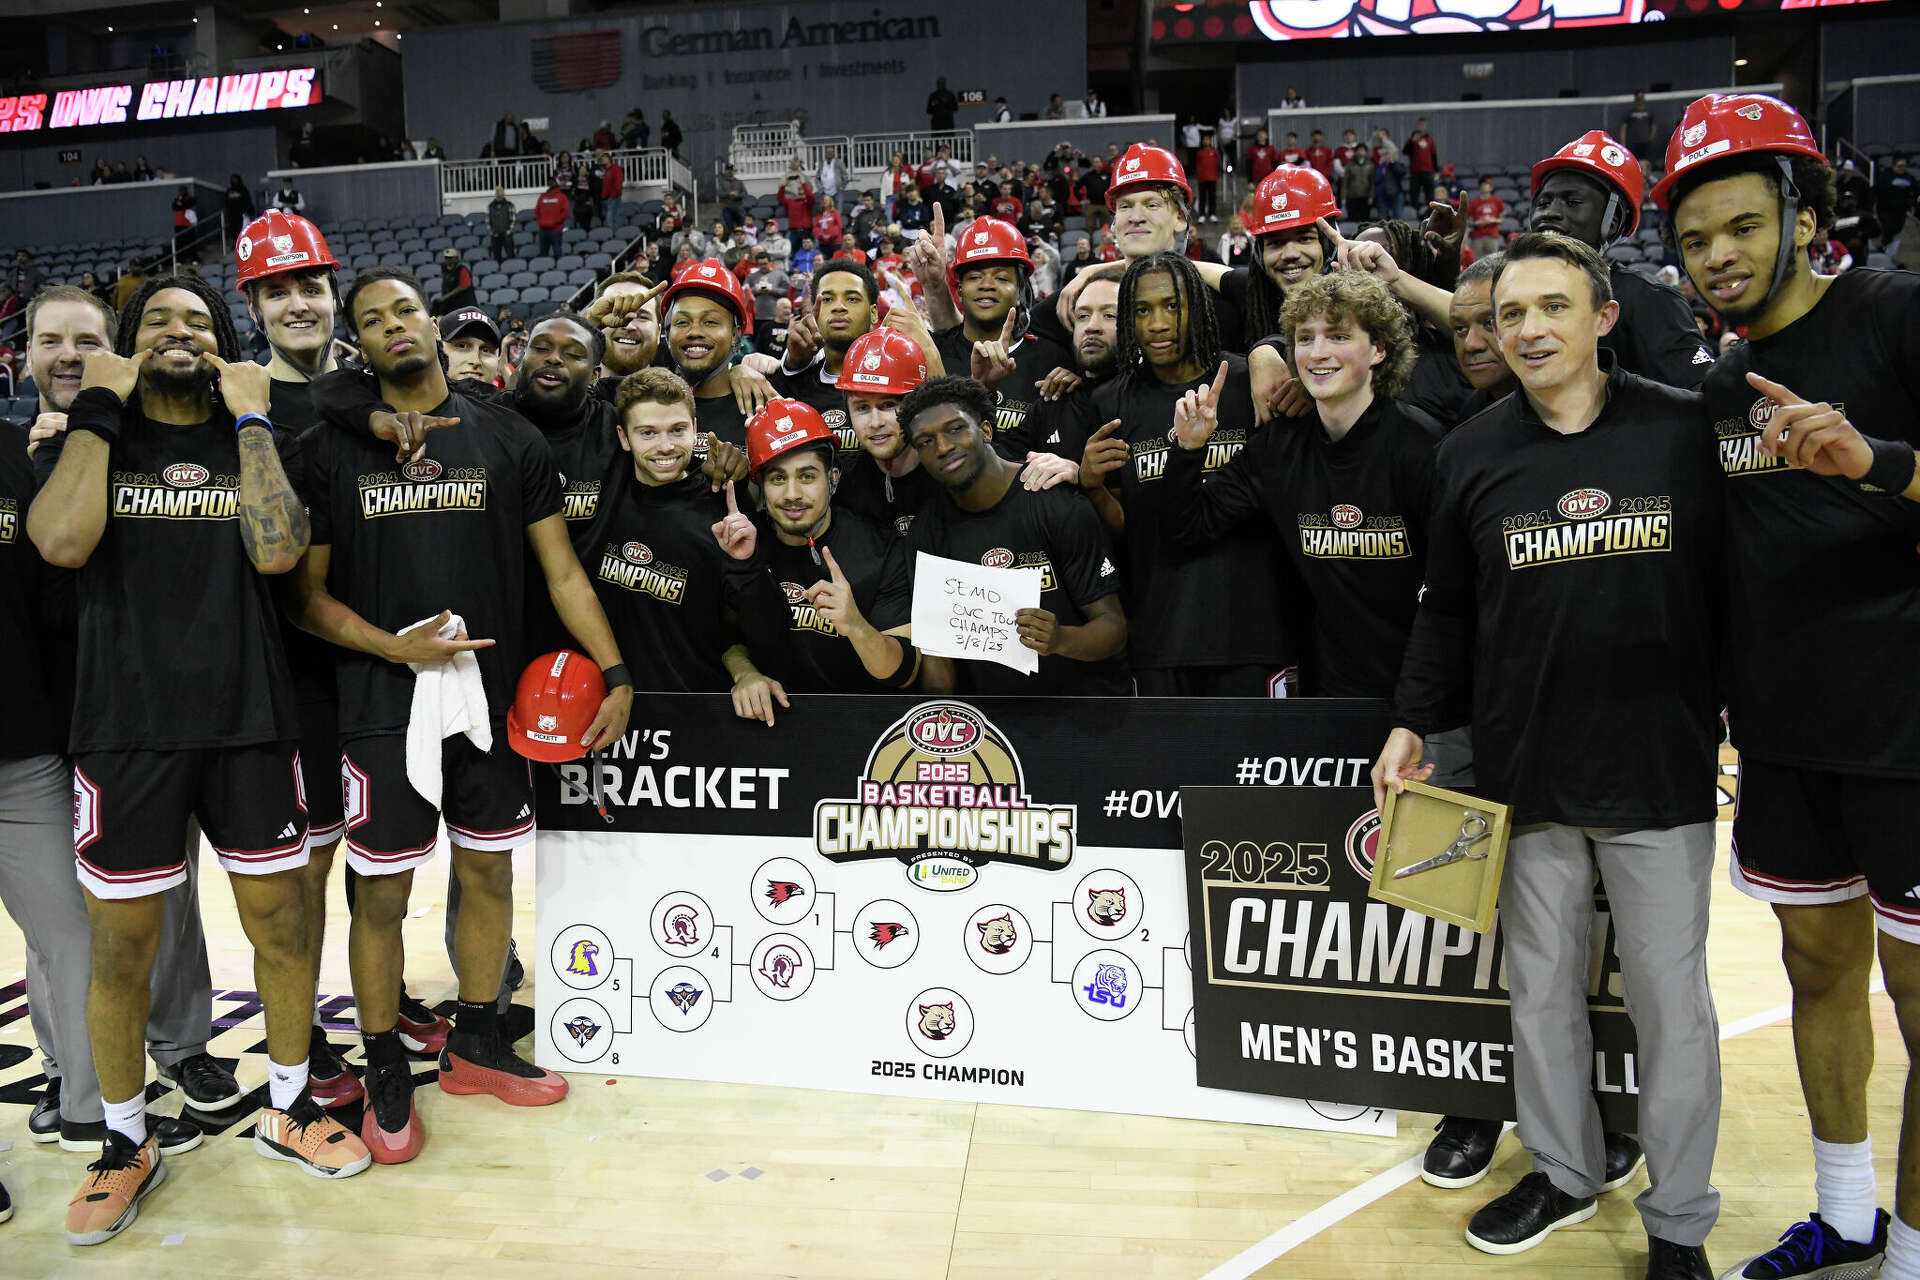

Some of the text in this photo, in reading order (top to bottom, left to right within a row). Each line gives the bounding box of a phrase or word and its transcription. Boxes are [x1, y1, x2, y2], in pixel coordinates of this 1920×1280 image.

[641, 8, 942, 57] German American
[49, 85, 133, 128] OVC
[136, 68, 316, 121] CHAMPS
[962, 91, 983, 102] 106
[62, 151, 78, 162] 104
[1688, 147, 1710, 163] POLK
[1271, 211, 1292, 220] THOMAS
[271, 252, 304, 263] THOMPSON
[860, 374, 880, 382] DILLON
[113, 473, 159, 487] 2024
[172, 470, 200, 482] OVC
[358, 465, 487, 488] 2024 OVC 2025
[115, 487, 241, 517] CHAMPION
[364, 482, 483, 516] CHAMPIONS
[1335, 511, 1357, 523] OVC
[1367, 516, 1404, 530] 2025
[1502, 495, 1672, 532] 2024 OVC 2025
[1302, 529, 1404, 556] CHAMPIONS
[1509, 515, 1669, 567] CHAMPIONS
[627, 547, 647, 561] OVC
[984, 553, 1007, 566] OVC
[600, 556, 684, 601] HAMPIONS
[944, 578, 1001, 603] SEMO
[953, 603, 984, 620] OVC
[949, 617, 1009, 641] CHAMPS
[955, 634, 1003, 653] 3/8/25
[533, 732, 558, 742] PICKETT
[921, 722, 967, 742] OVC
[582, 729, 671, 760] N'S
[917, 762, 970, 783] 2025
[1235, 756, 1370, 787] #OVCIT
[560, 764, 790, 810] BRACKET
[863, 782, 1026, 808] BASKETBALL
[1103, 790, 1183, 819] #OV
[817, 804, 1073, 864] CHAMPIONSHIPS
[910, 851, 974, 864] PRESENTED BY
[1200, 840, 1331, 886] 2025
[814, 913, 820, 926] 1
[1140, 928, 1150, 942] 2
[711, 946, 719, 959] 4
[612, 979, 620, 991] 5
[1240, 1021, 1358, 1069] MEN'S
[611, 1052, 620, 1065] 8
[871, 1060, 1025, 1087] 2025 CHAMPION
[1373, 1109, 1384, 1123] 7
